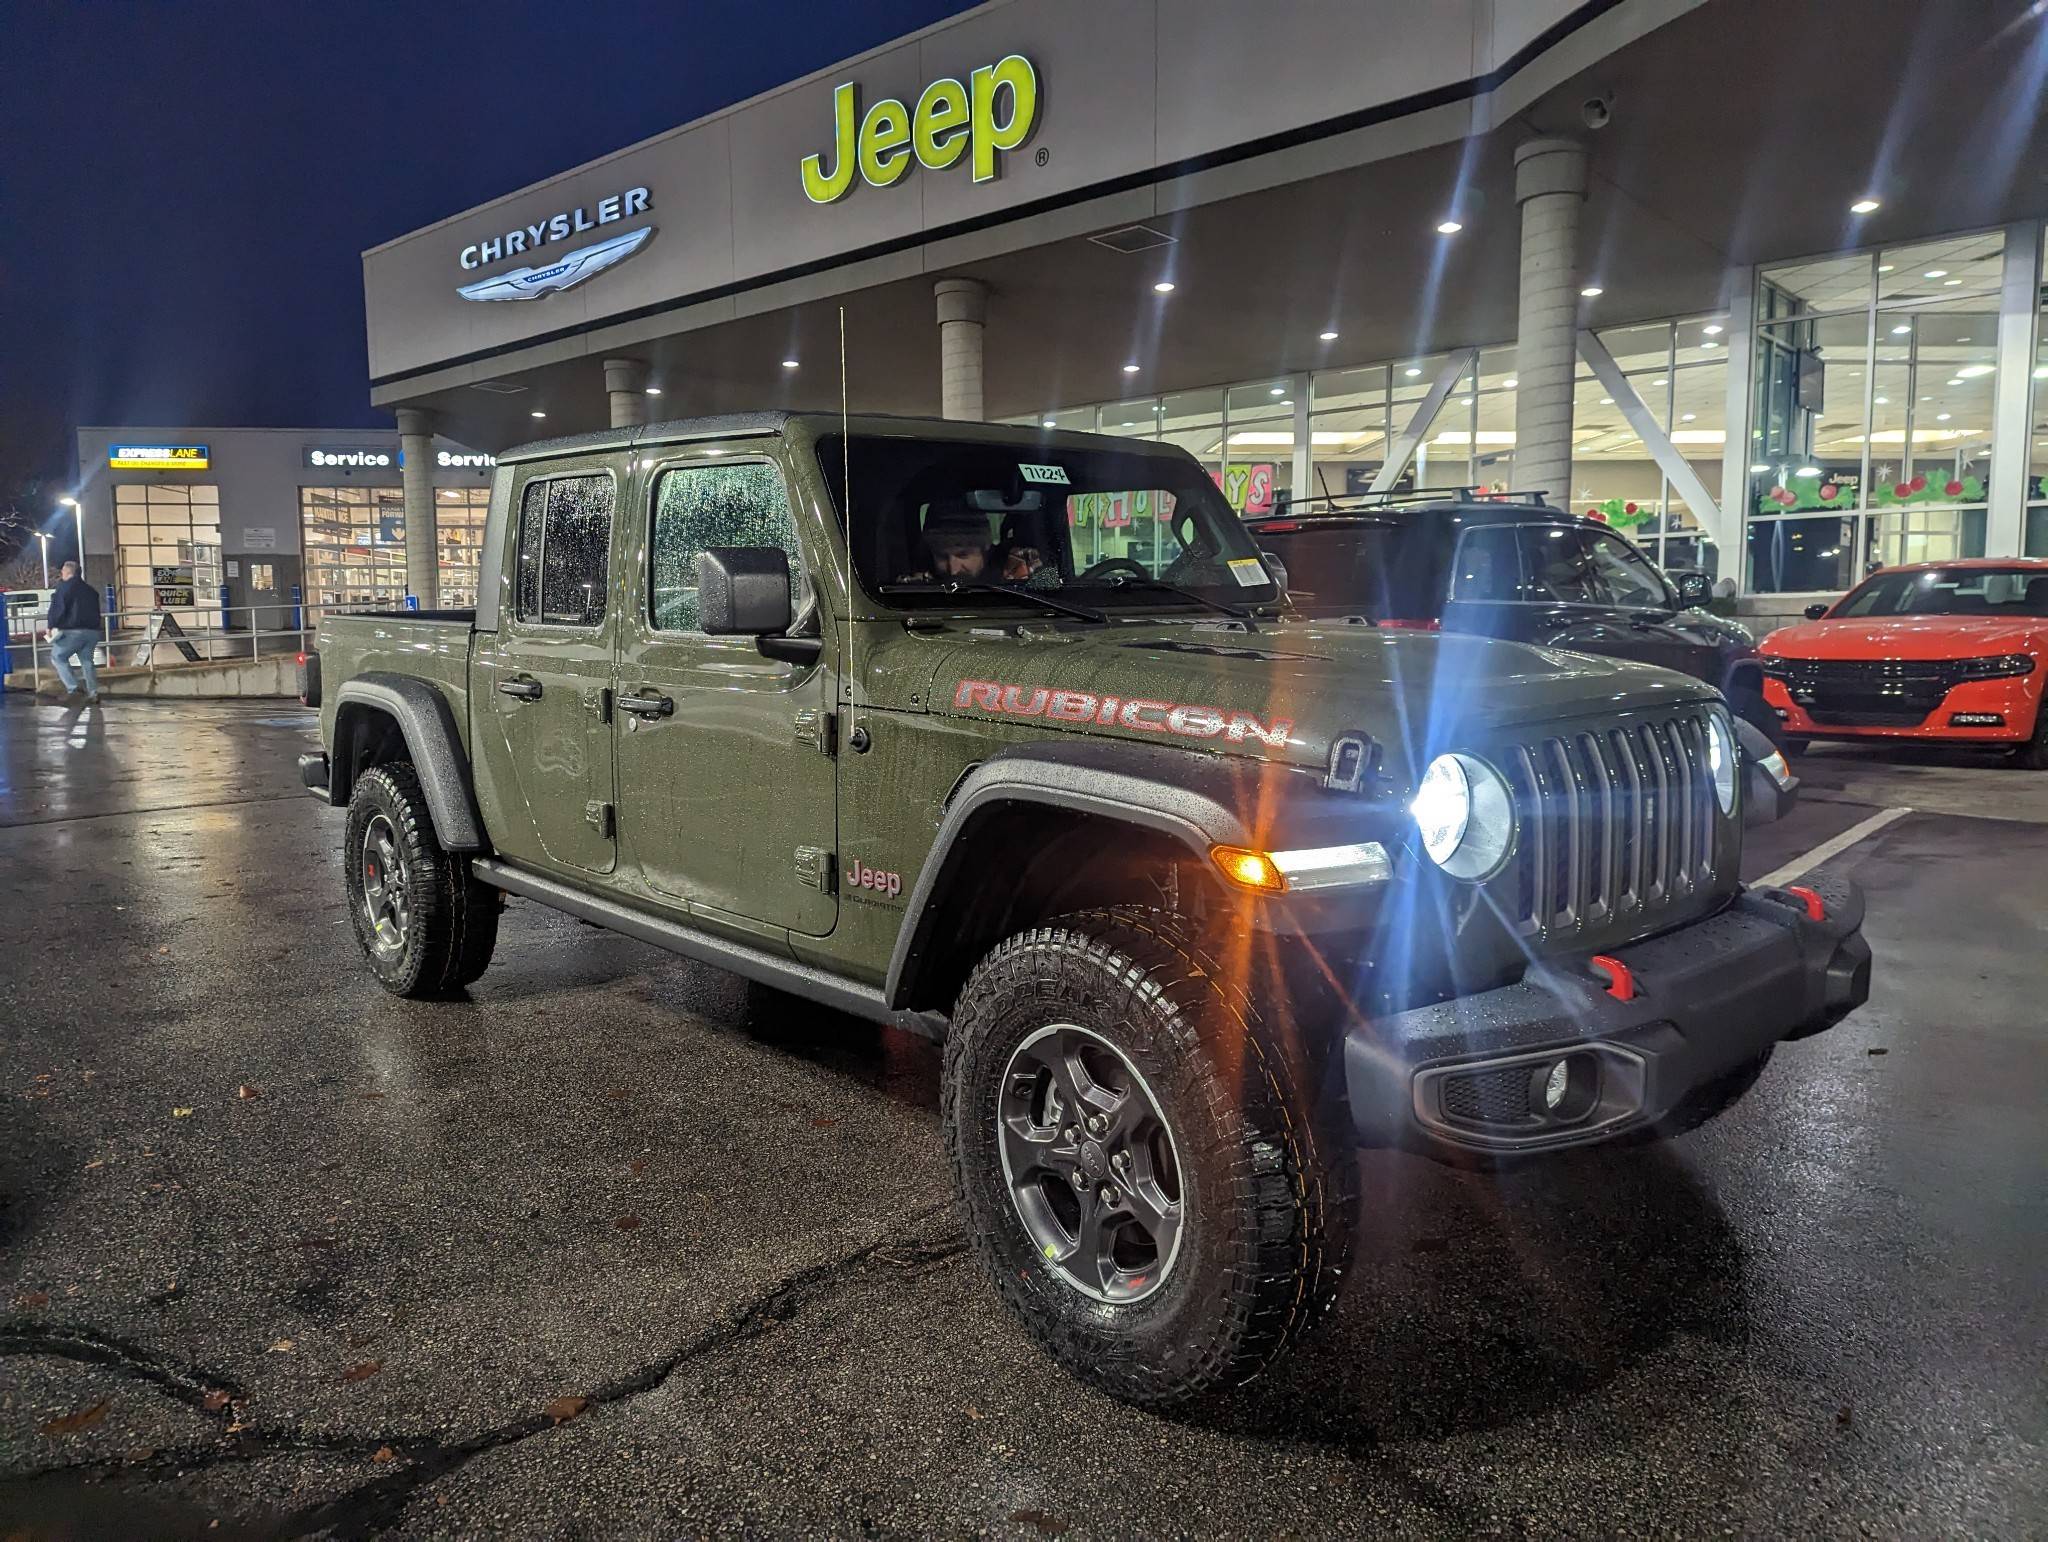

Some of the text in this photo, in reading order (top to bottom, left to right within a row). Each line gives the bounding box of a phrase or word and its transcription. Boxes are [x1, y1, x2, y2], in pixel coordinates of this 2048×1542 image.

[802, 55, 1036, 203] Jeep
[460, 187, 649, 270] CHRYSLER
[527, 266, 565, 282] CHRYSLER
[311, 450, 390, 466] Service
[1024, 467, 1065, 481] 71224
[953, 679, 1295, 748] RUBICON
[846, 859, 901, 899] Jeep
